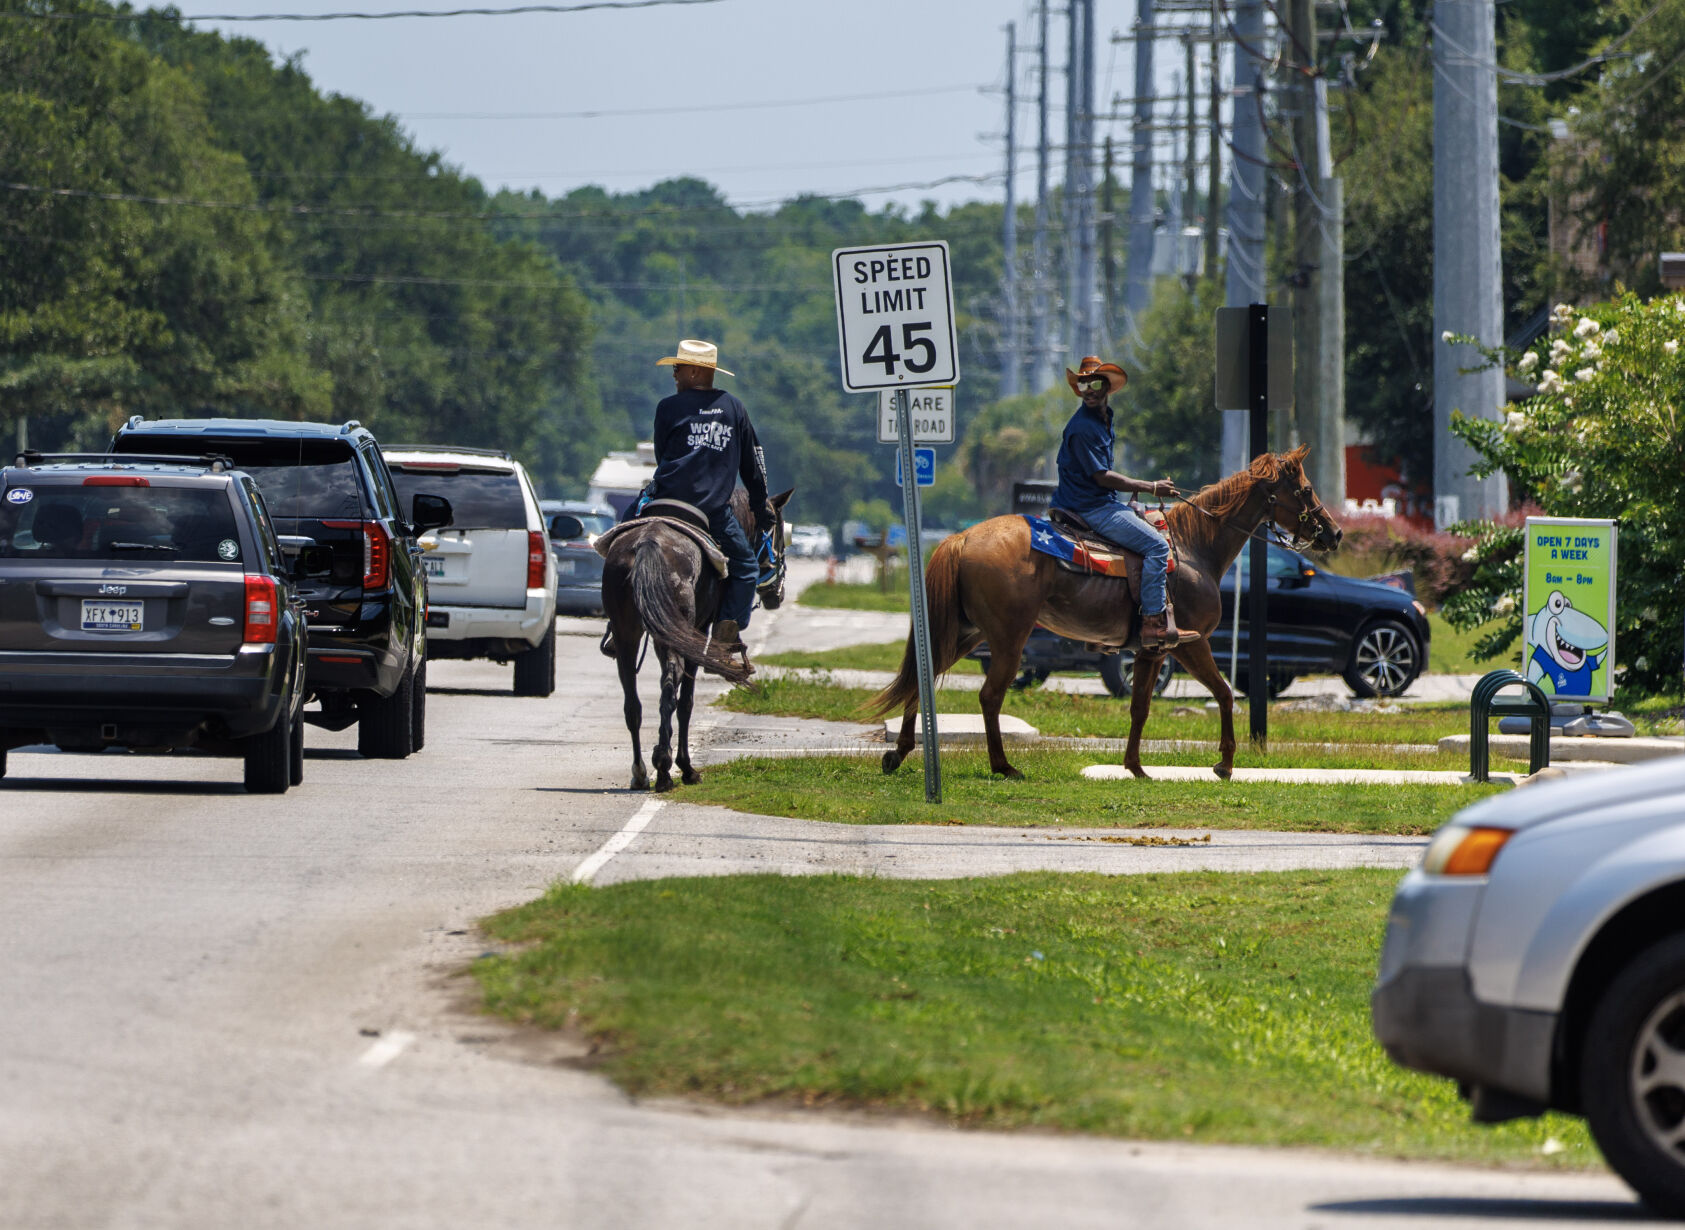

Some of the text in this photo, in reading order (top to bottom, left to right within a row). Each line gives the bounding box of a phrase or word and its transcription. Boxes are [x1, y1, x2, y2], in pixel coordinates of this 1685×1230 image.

[853, 256, 931, 284] SPEED
[861, 287, 927, 314] LIMIT
[862, 321, 937, 376] 45
[889, 397, 944, 411] SARE
[690, 421, 733, 440] WORK
[914, 419, 945, 434] ROAD
[687, 431, 731, 448] SMART
[1537, 535, 1600, 549] OPEN 7 DAYS
[1551, 548, 1588, 560] A WEEK
[98, 584, 127, 595] Jeep
[85, 608, 139, 623] XFX 913
